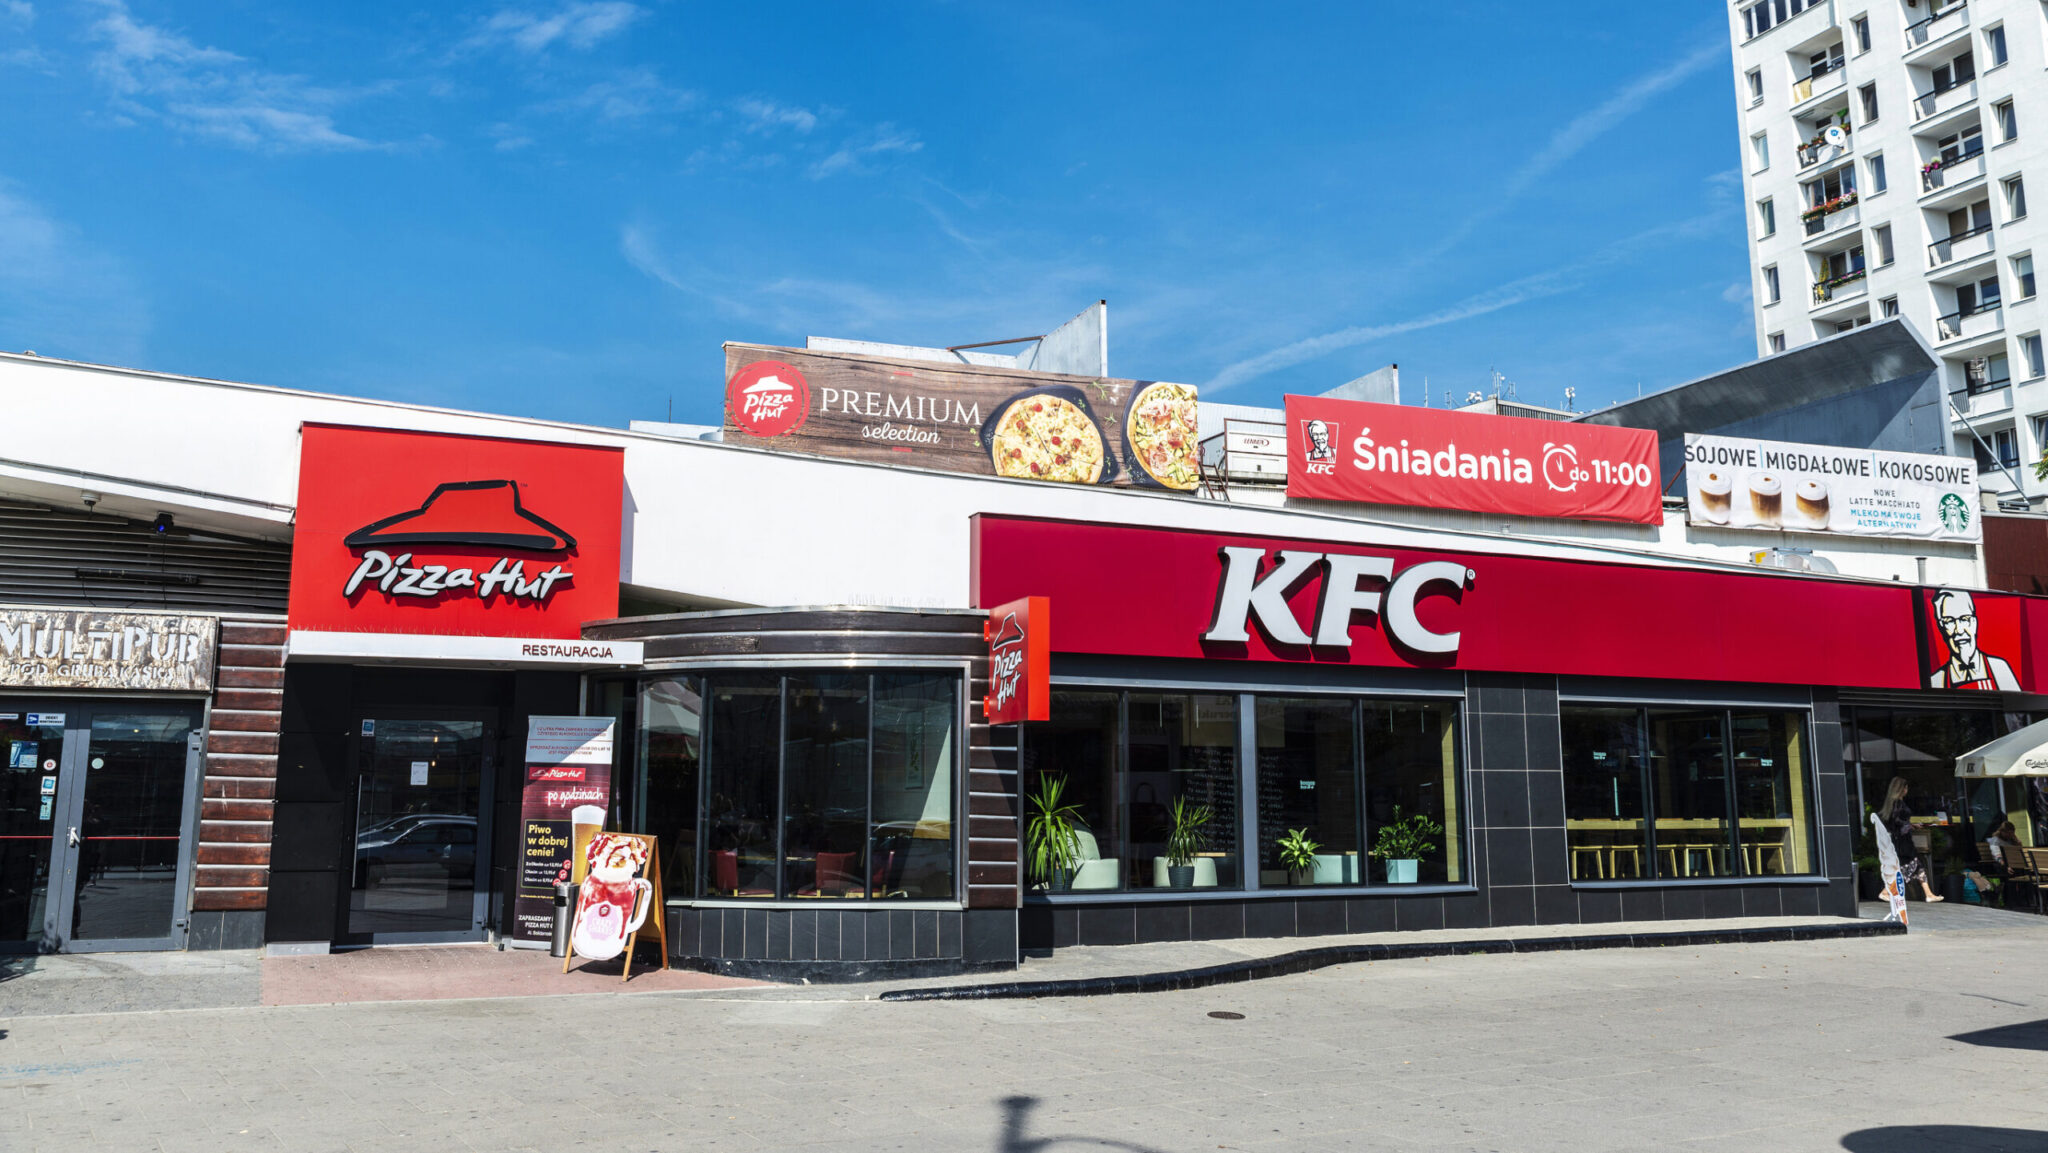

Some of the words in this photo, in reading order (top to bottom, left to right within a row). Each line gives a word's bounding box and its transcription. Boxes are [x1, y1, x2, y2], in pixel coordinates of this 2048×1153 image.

[743, 391, 795, 414] Pizza
[820, 387, 982, 426] PREMIUM
[751, 404, 789, 423] Hut
[861, 421, 941, 444] selection
[1353, 427, 1533, 484] Śniadania
[1569, 466, 1590, 482] do
[1591, 459, 1652, 487] 11:00
[1684, 444, 1757, 468] SOJOWE
[1765, 451, 1870, 477] MIGDAŁOWE
[1879, 461, 1971, 485] KOKOSOWE
[1306, 463, 1335, 475] KFC
[1873, 489, 1896, 497] NOWE
[1849, 497, 1874, 506] LATTE
[1877, 499, 1921, 509] MACCHIATO
[1850, 508, 1880, 518] MLEKO
[1880, 510, 1892, 518] MA
[1893, 511, 1921, 520] SWOJE
[1857, 519, 1918, 529] ALTERNATYWY
[343, 550, 475, 598] Pizza
[477, 556, 574, 600] Hut
[1203, 545, 1468, 654] KFC
[522, 644, 613, 658] RESTAURACJA
[992, 647, 1023, 691] Pizza
[997, 671, 1021, 712] Hut
[548, 769, 567, 778] Pizza
[568, 769, 583, 778] Hut
[547, 790, 559, 807] po
[560, 785, 604, 808] godzinach
[528, 824, 552, 835] Piwo
[527, 838, 537, 846] w
[538, 836, 569, 848] dobrej
[526, 847, 555, 857] cenie!
[518, 914, 552, 922] ZAPRASZAMY
